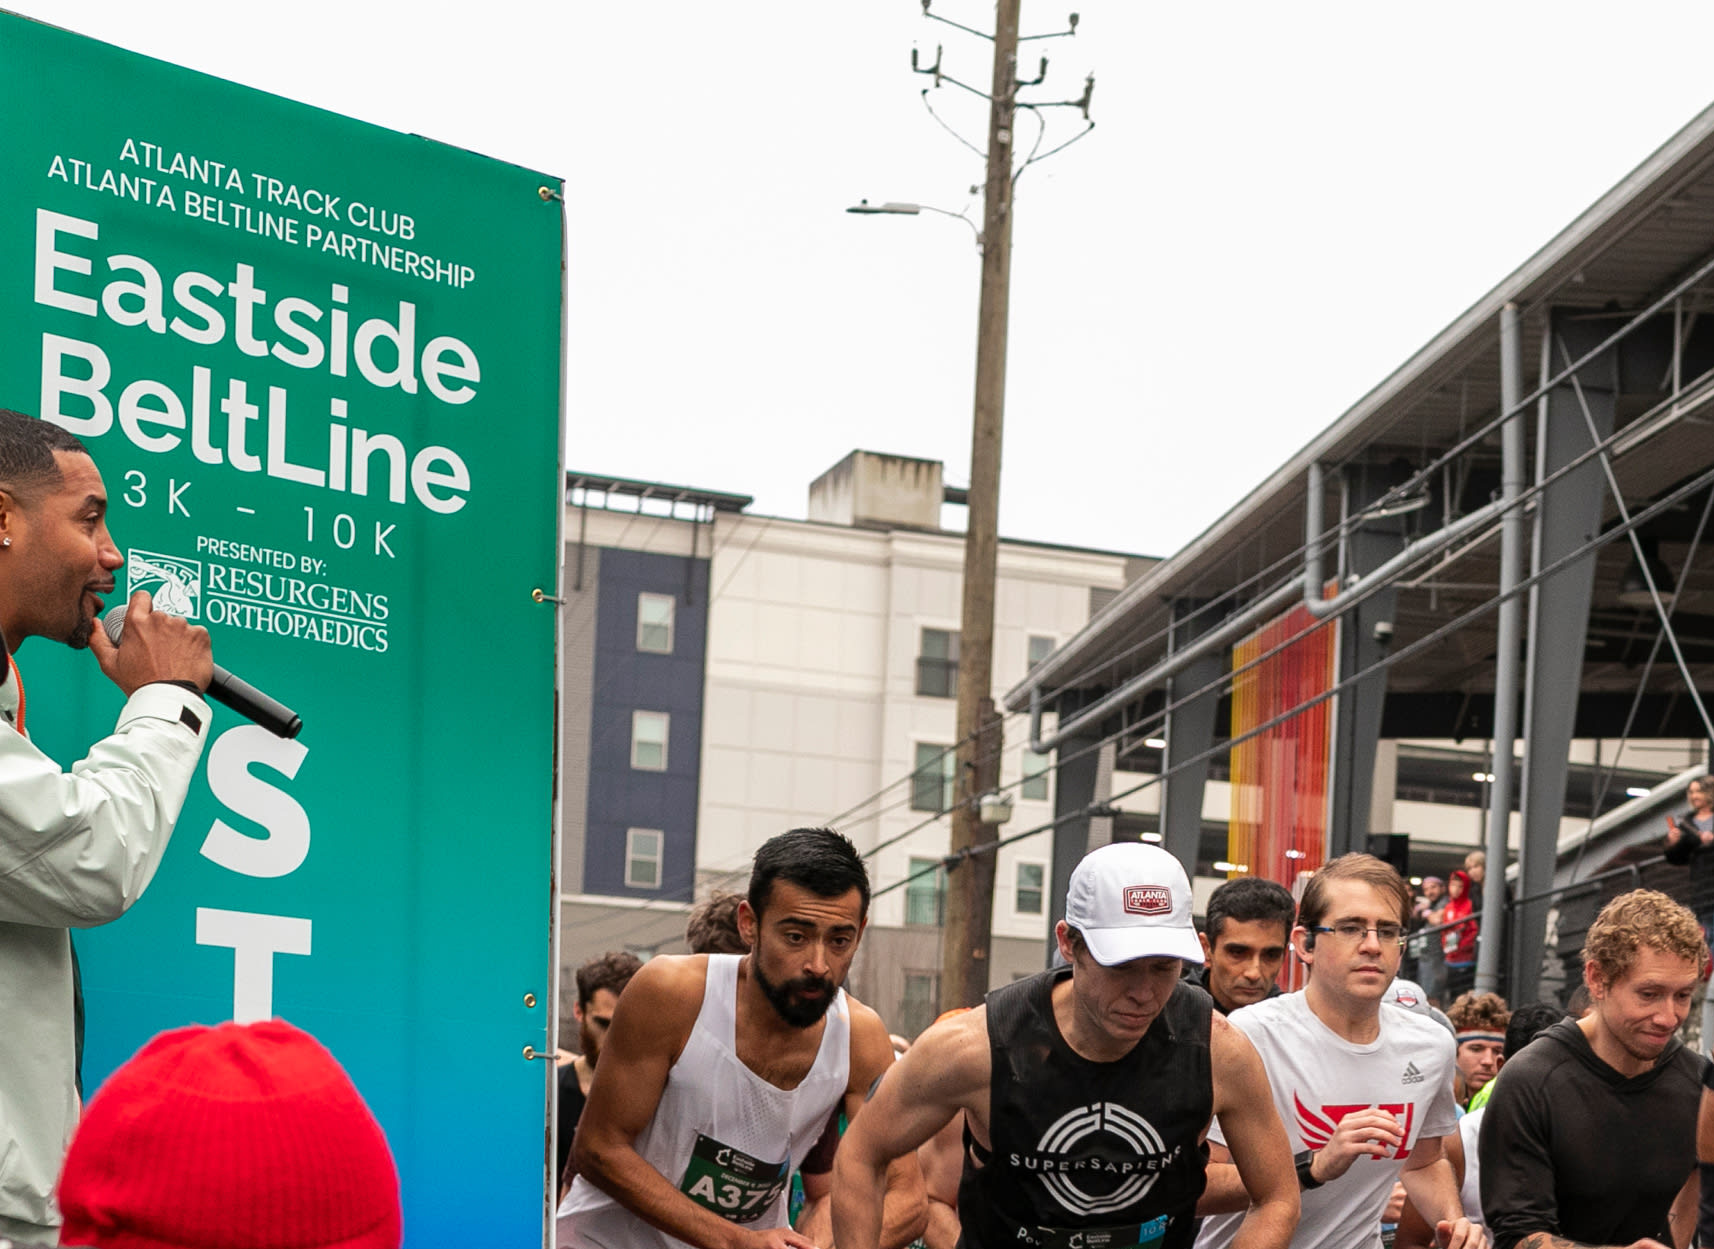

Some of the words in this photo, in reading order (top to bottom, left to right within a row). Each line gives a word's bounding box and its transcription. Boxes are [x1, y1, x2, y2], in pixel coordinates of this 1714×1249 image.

[47, 155, 176, 211] ATLANTA
[185, 190, 299, 244] BELTLINE
[306, 224, 475, 289] PARTNERSHIP
[119, 138, 244, 194] ATLANTA
[251, 173, 340, 221] TRACK
[348, 202, 415, 240] CLUB
[34, 207, 481, 405] Eastside
[41, 332, 471, 514] BeltLine
[197, 535, 296, 570] PRESENTED
[300, 556, 328, 577] BY:
[207, 563, 389, 620] RESURGENS
[206, 599, 388, 653] ORTHOPAEDICS
[687, 1175, 784, 1211] A375
